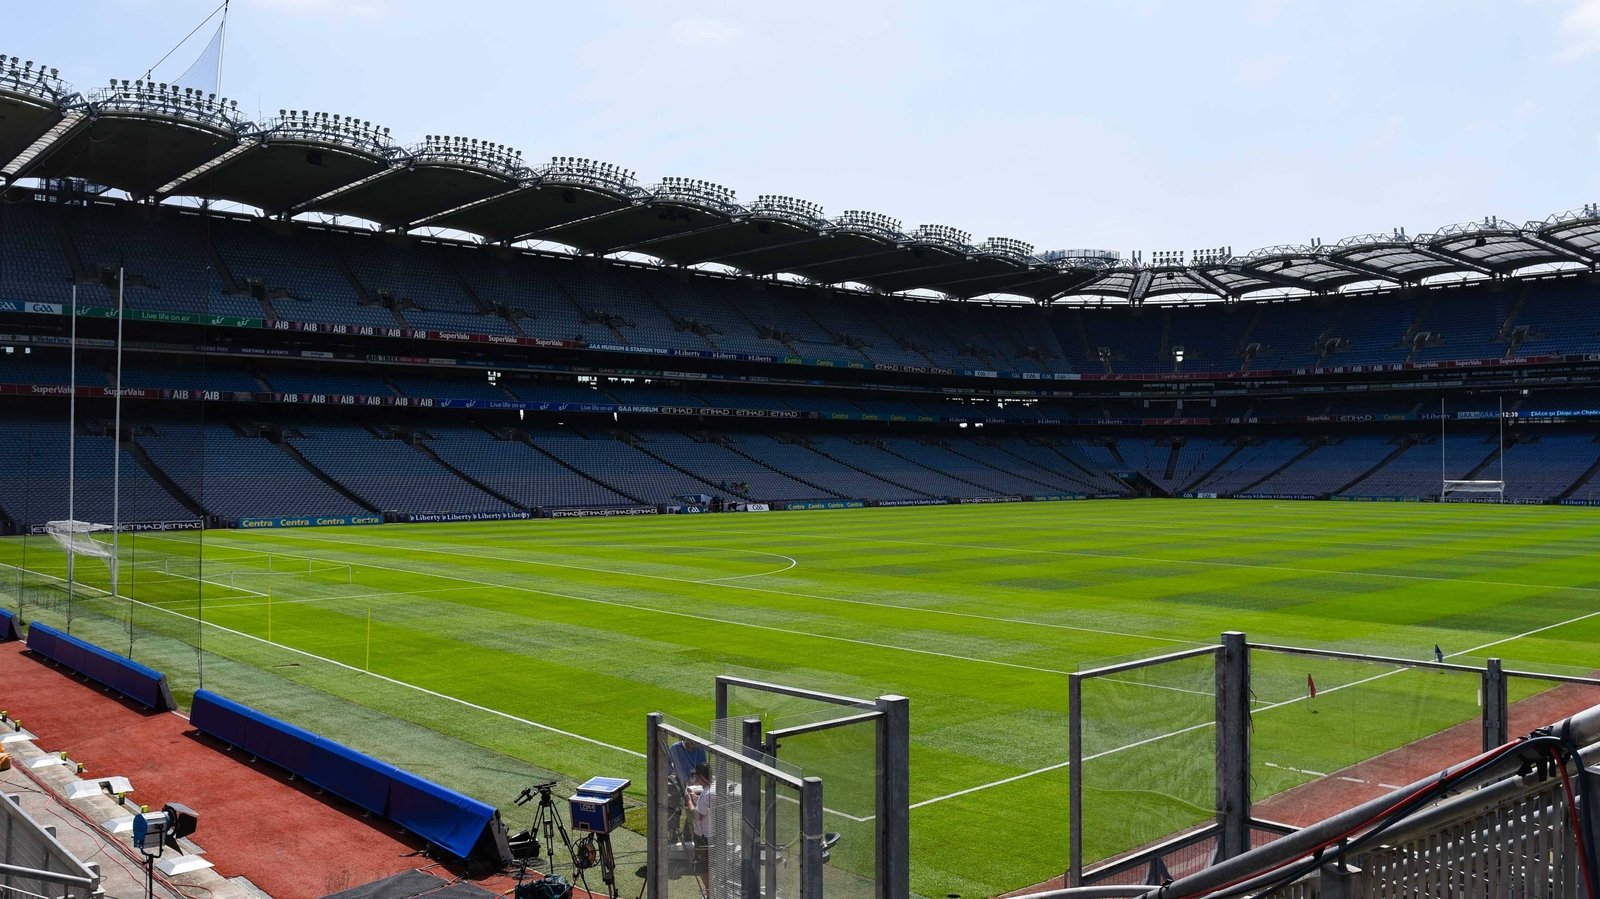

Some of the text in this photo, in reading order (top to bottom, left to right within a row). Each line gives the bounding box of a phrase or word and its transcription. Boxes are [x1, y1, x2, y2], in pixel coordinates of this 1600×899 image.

[33, 304, 53, 313] GAA
[275, 321, 289, 329] AIB
[304, 323, 317, 331] AIB
[333, 325, 346, 333] AIB
[360, 327, 373, 335] AIB
[388, 329, 401, 337] AIB
[439, 332, 470, 340] SuperValu
[488, 335, 517, 343] SuperValu
[173, 390, 189, 399] AIB
[204, 391, 219, 400] AIB
[283, 394, 298, 402] AIB
[311, 394, 326, 403] AIB
[341, 396, 354, 404] AIB
[395, 398, 408, 406] AIB
